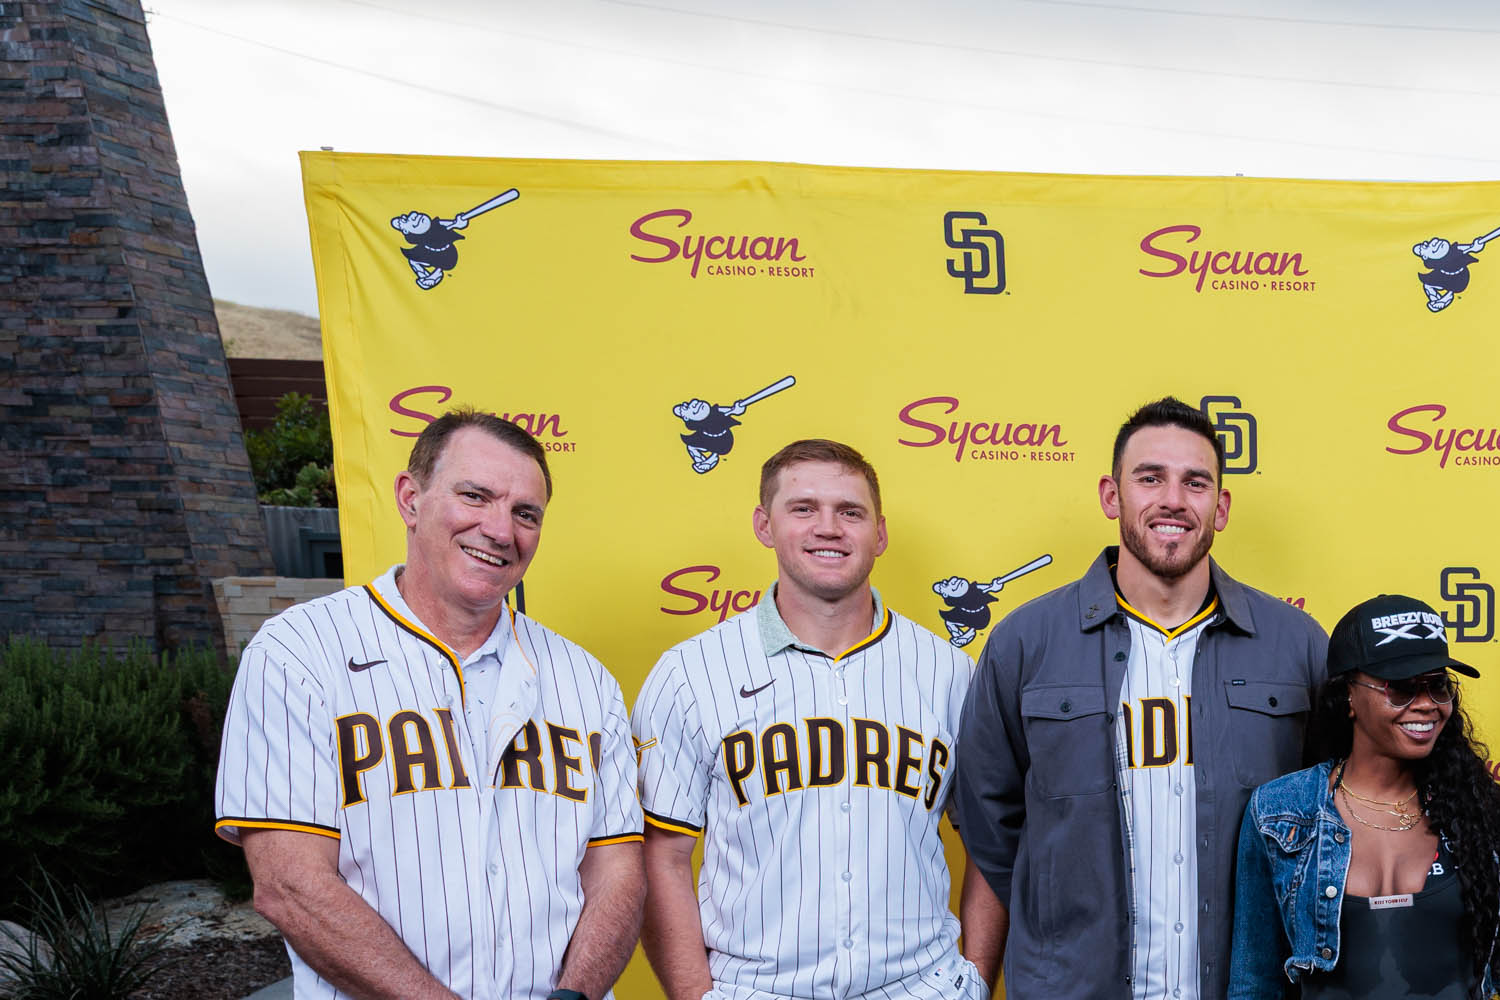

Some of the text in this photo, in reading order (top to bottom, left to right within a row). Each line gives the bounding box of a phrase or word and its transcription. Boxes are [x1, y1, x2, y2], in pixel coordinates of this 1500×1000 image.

[630, 209, 806, 278] Sycuan
[1139, 225, 1308, 293] Sycuan
[707, 265, 815, 278] CASINO RESORT
[1212, 280, 1315, 291] CASINO RESORT
[389, 386, 568, 437] San
[898, 396, 1068, 462] Sycuan
[541, 443, 576, 452] SORT
[971, 450, 1075, 461] CASINO RESORT
[1455, 456, 1500, 465] CASINO
[661, 565, 761, 624] Syc
[1372, 612, 1421, 630] BREEZY
[335, 709, 601, 809] PARE
[722, 717, 950, 812] PADRES
